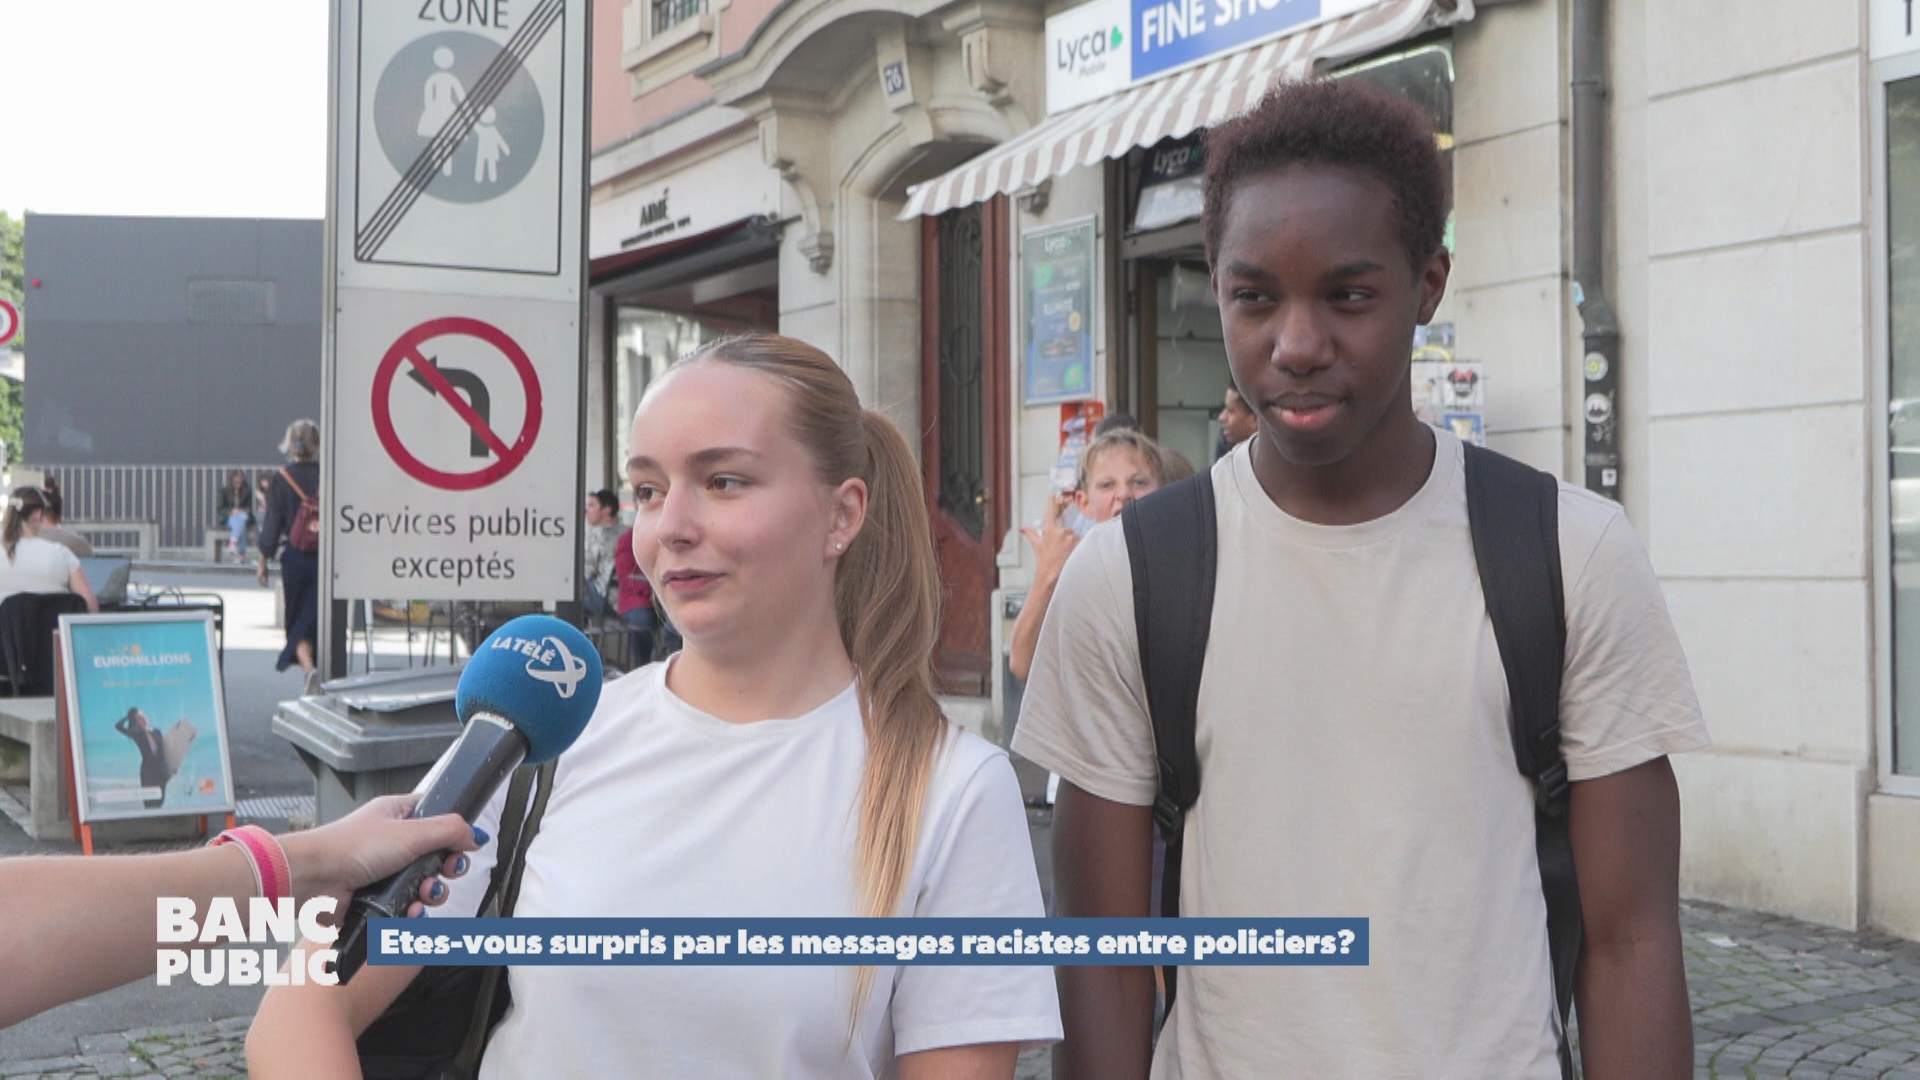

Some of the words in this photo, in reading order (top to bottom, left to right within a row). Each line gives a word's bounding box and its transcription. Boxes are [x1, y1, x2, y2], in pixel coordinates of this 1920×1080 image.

[418, 0, 509, 30] ZONE
[1142, 0, 1206, 53] FINE
[1057, 28, 1107, 72] Lyca
[340, 504, 457, 535] Services
[468, 507, 566, 544] publics
[391, 551, 516, 587] exceptés
[93, 653, 192, 669] EUROMILLIONS
[490, 636, 513, 650] LA
